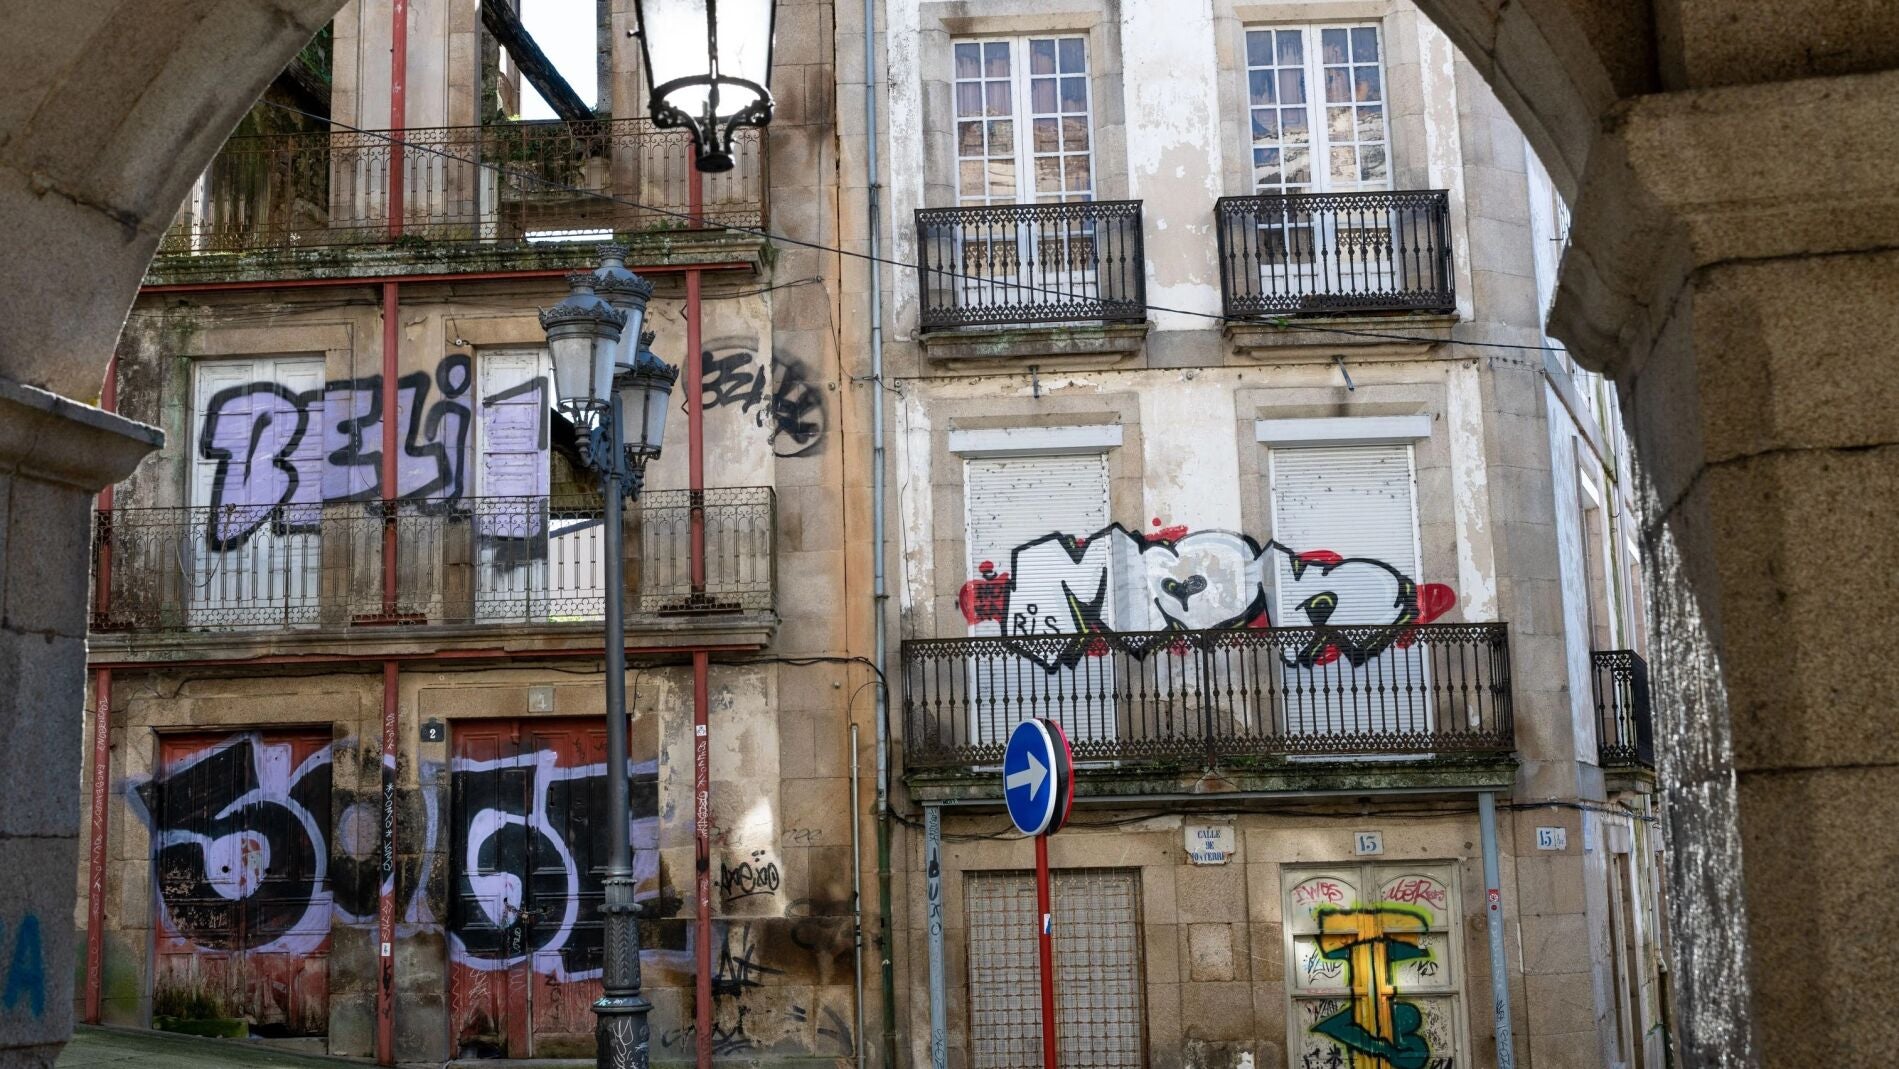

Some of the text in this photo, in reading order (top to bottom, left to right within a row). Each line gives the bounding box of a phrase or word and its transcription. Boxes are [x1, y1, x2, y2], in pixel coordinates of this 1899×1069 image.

[429, 728, 437, 739] 2
[1197, 830, 1222, 839] CALLE
[1540, 830, 1552, 847] 15
